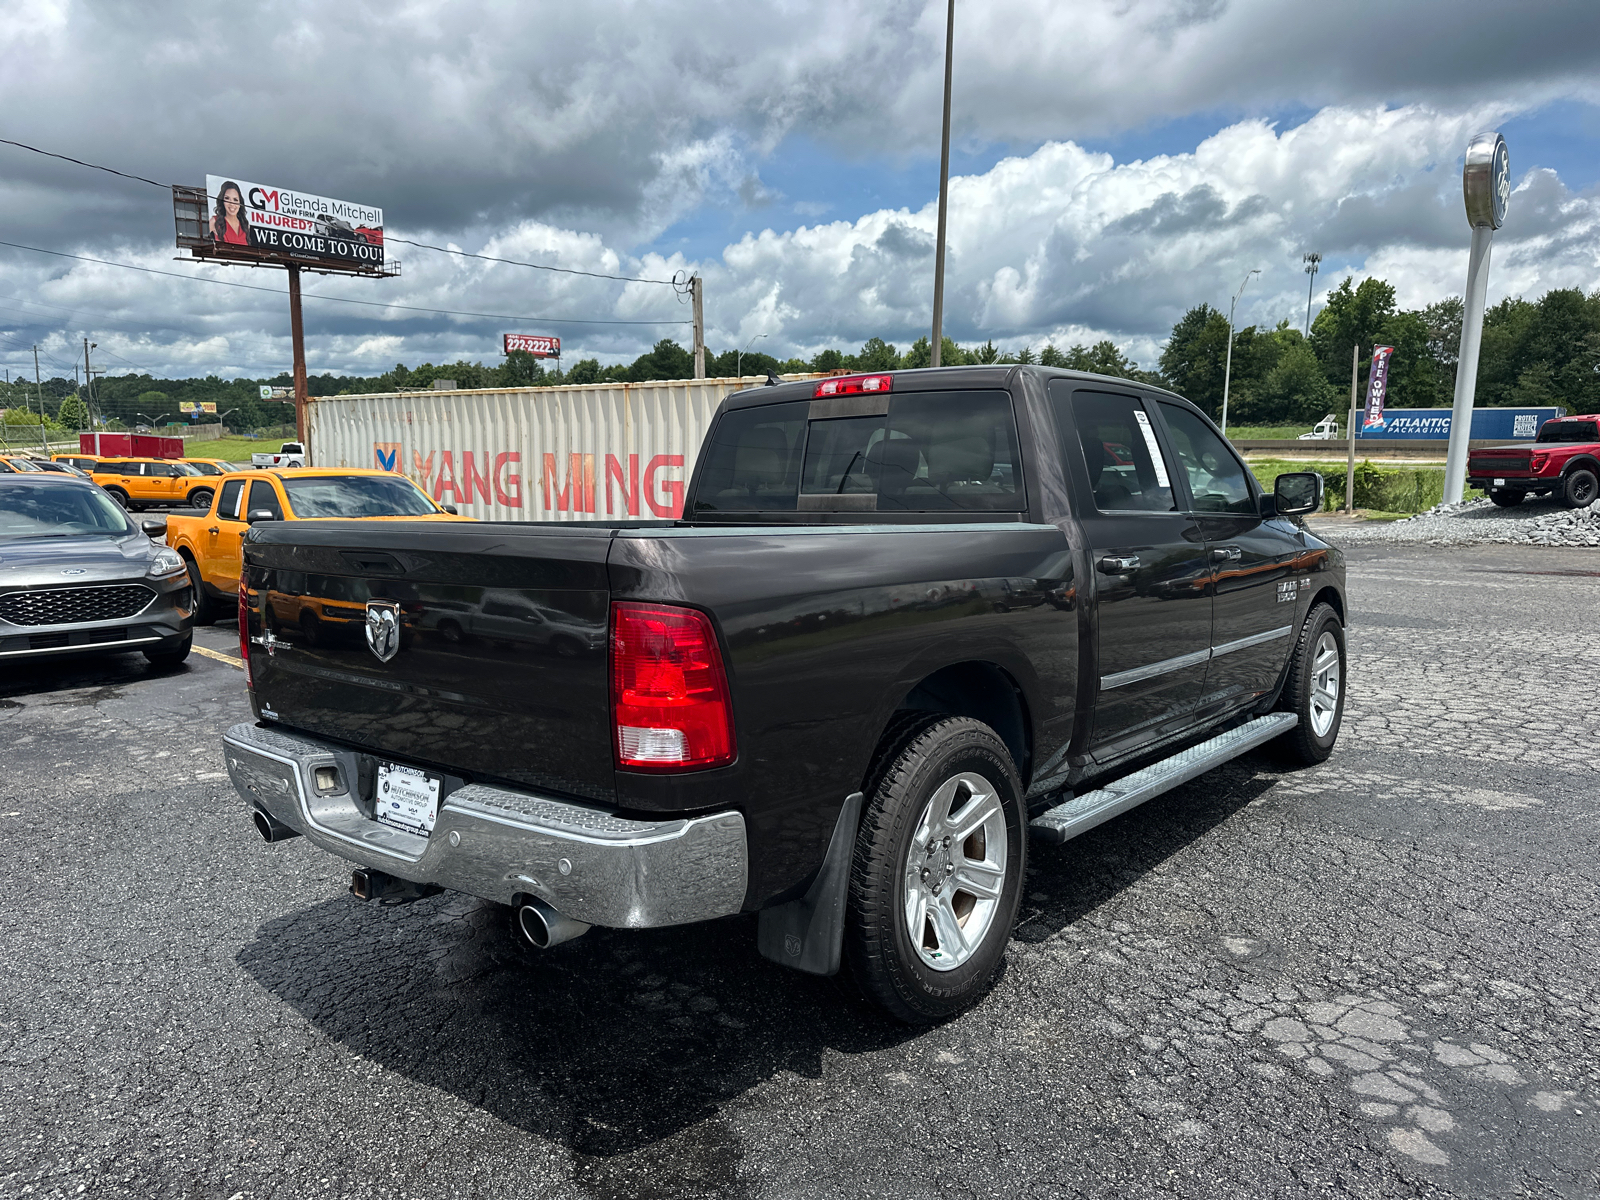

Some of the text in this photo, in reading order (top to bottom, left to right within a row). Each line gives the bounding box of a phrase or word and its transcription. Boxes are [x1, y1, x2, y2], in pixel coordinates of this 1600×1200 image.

[279, 192, 381, 223] Glenda Mitchell
[282, 207, 315, 219] LAW FIRM
[251, 211, 313, 231] INJURED?
[254, 228, 383, 262] WE COME TO YOU!
[1376, 352, 1387, 378] PRE
[1369, 380, 1384, 422] OWNED
[1391, 417, 1451, 427] ATLANTIC
[413, 449, 685, 519] YANG MING
[391, 786, 429, 802] HUTCHINSON
